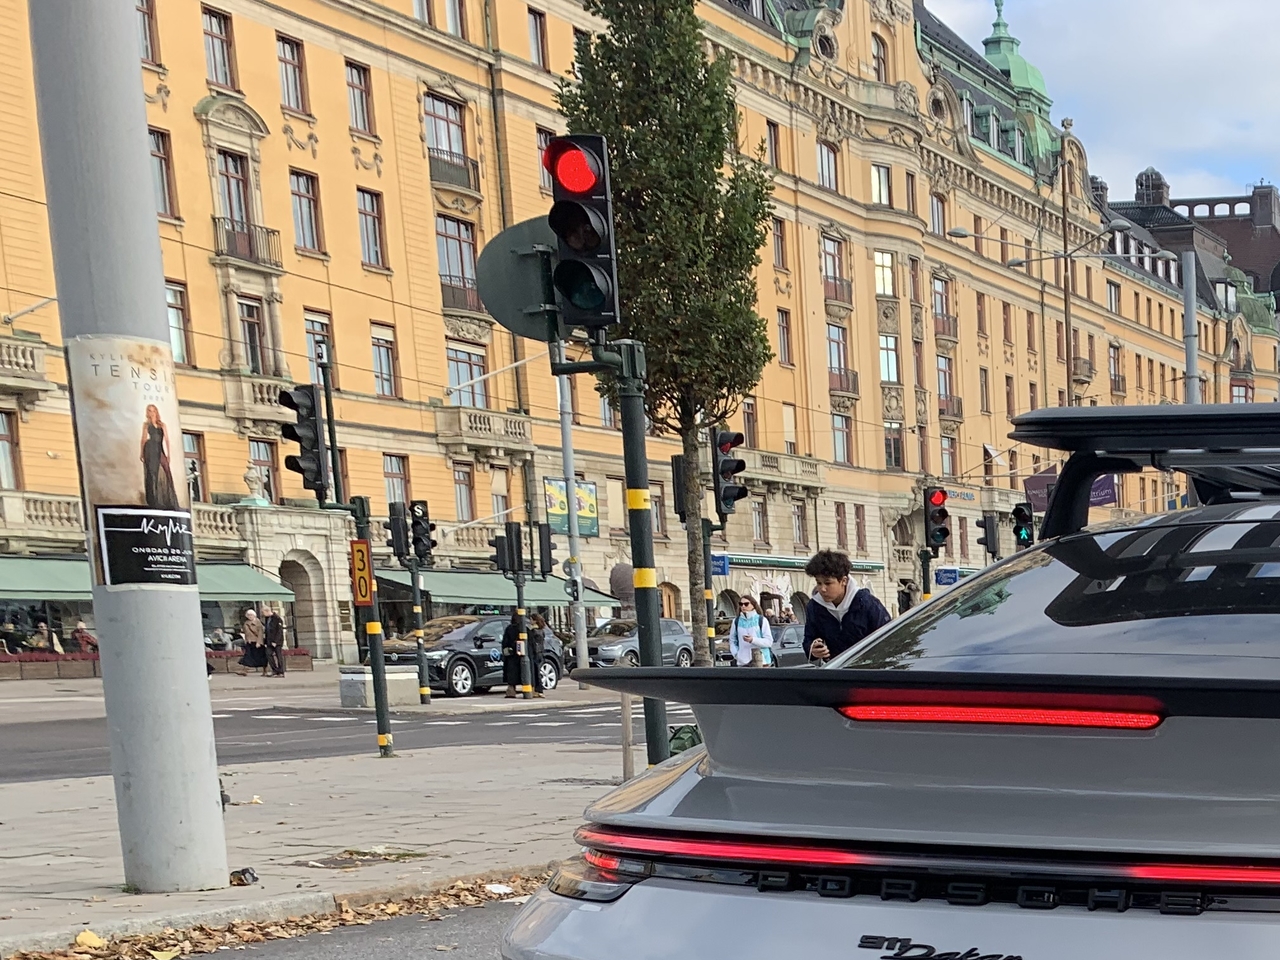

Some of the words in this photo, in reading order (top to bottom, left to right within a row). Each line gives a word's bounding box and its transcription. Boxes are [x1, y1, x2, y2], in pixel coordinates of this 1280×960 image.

[89, 353, 134, 361] KYLIE
[132, 381, 170, 394] TOUR
[141, 517, 194, 547] Kylie
[356, 548, 368, 598] 30
[757, 870, 1202, 915] PORSCHE
[857, 934, 912, 950] 911
